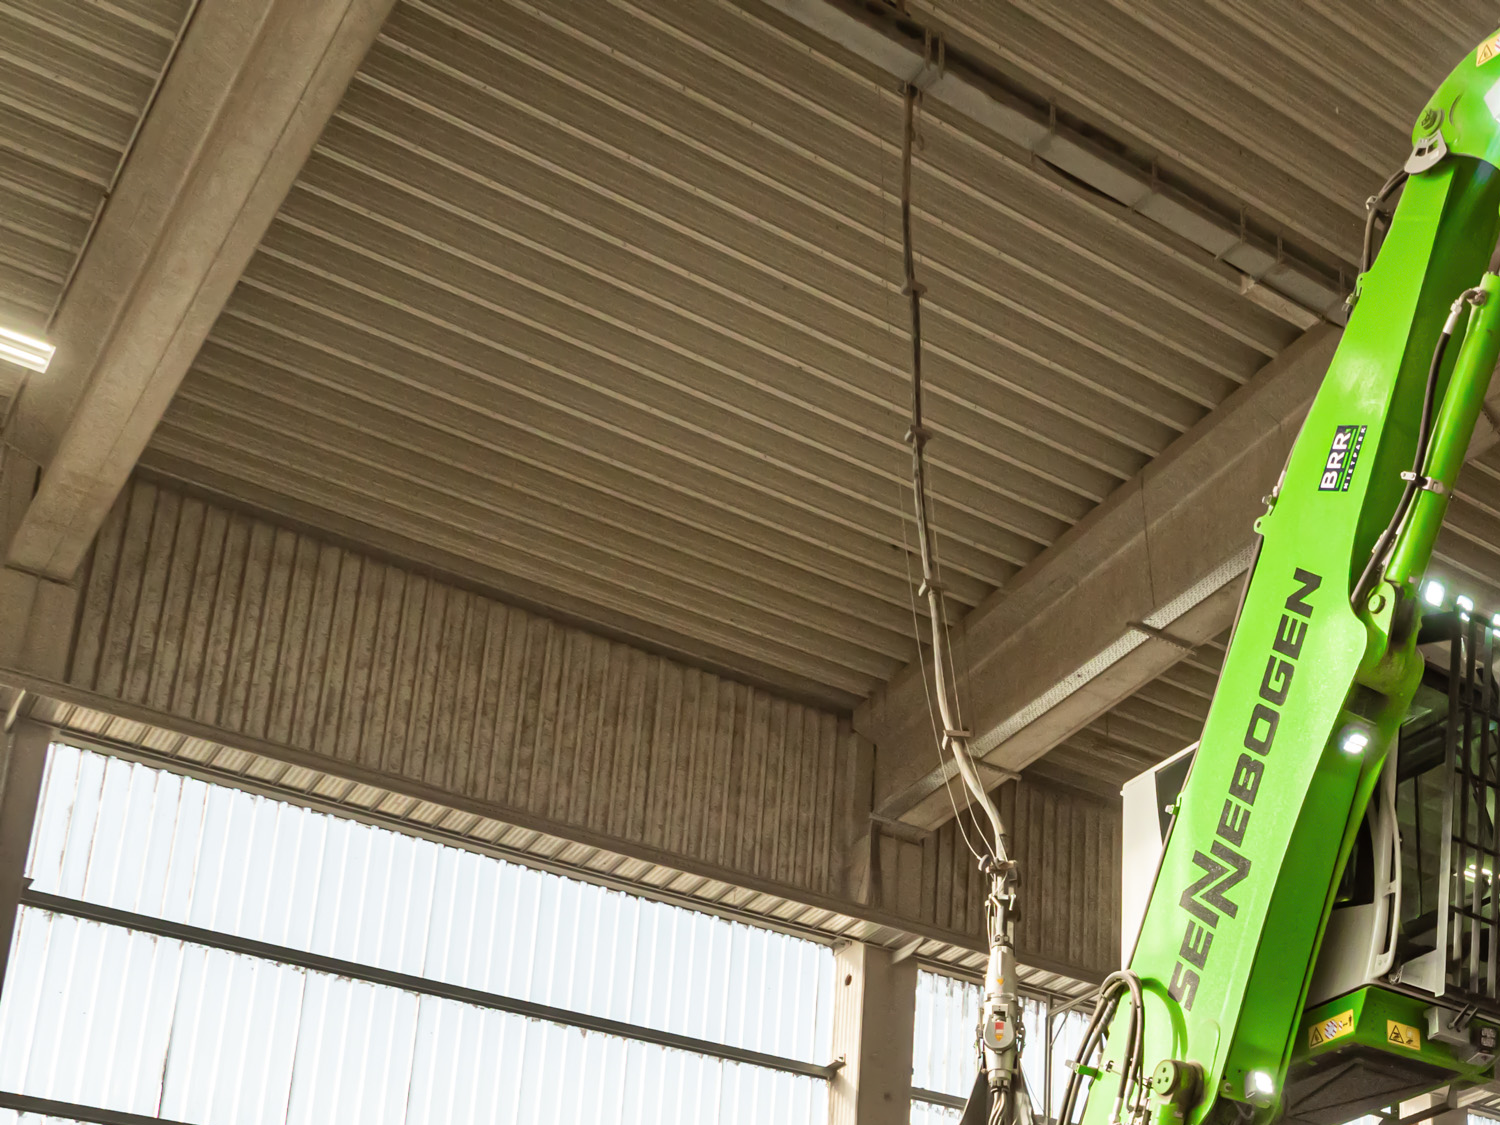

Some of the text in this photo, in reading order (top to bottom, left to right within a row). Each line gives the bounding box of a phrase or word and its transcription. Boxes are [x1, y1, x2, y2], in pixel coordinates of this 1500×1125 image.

[1320, 432, 1351, 488] BRR
[1343, 427, 1366, 489] MIETPARK
[1168, 567, 1323, 1011] SENNEBOGEN
